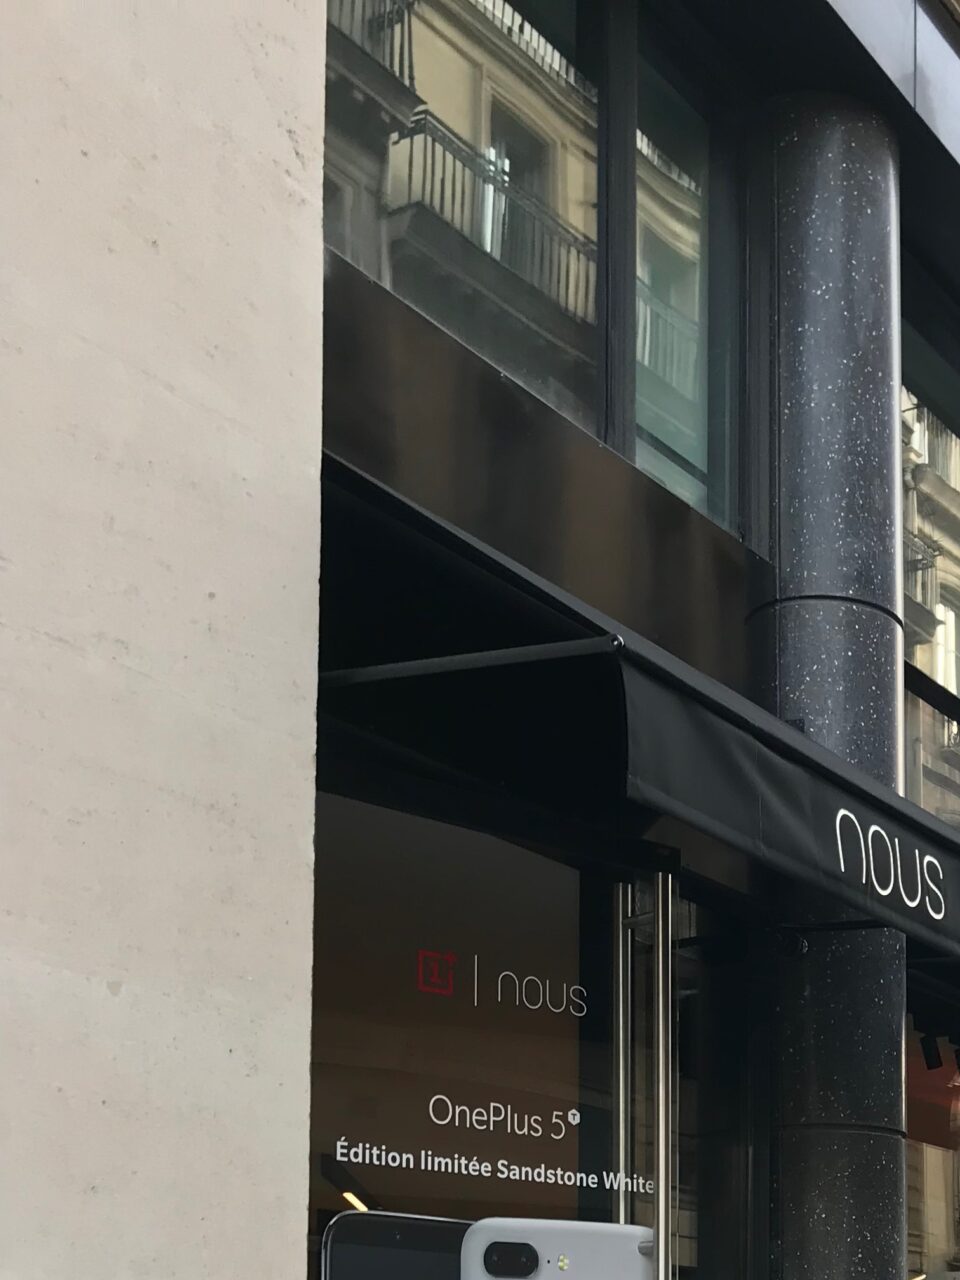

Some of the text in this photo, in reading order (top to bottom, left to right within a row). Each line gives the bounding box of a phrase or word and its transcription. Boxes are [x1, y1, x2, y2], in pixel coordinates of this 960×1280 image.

[836, 808, 945, 920] nous
[498, 971, 587, 1017] nous
[429, 1095, 543, 1137] OnePlus
[336, 1136, 655, 1194] Édition limitée Sandstone White
